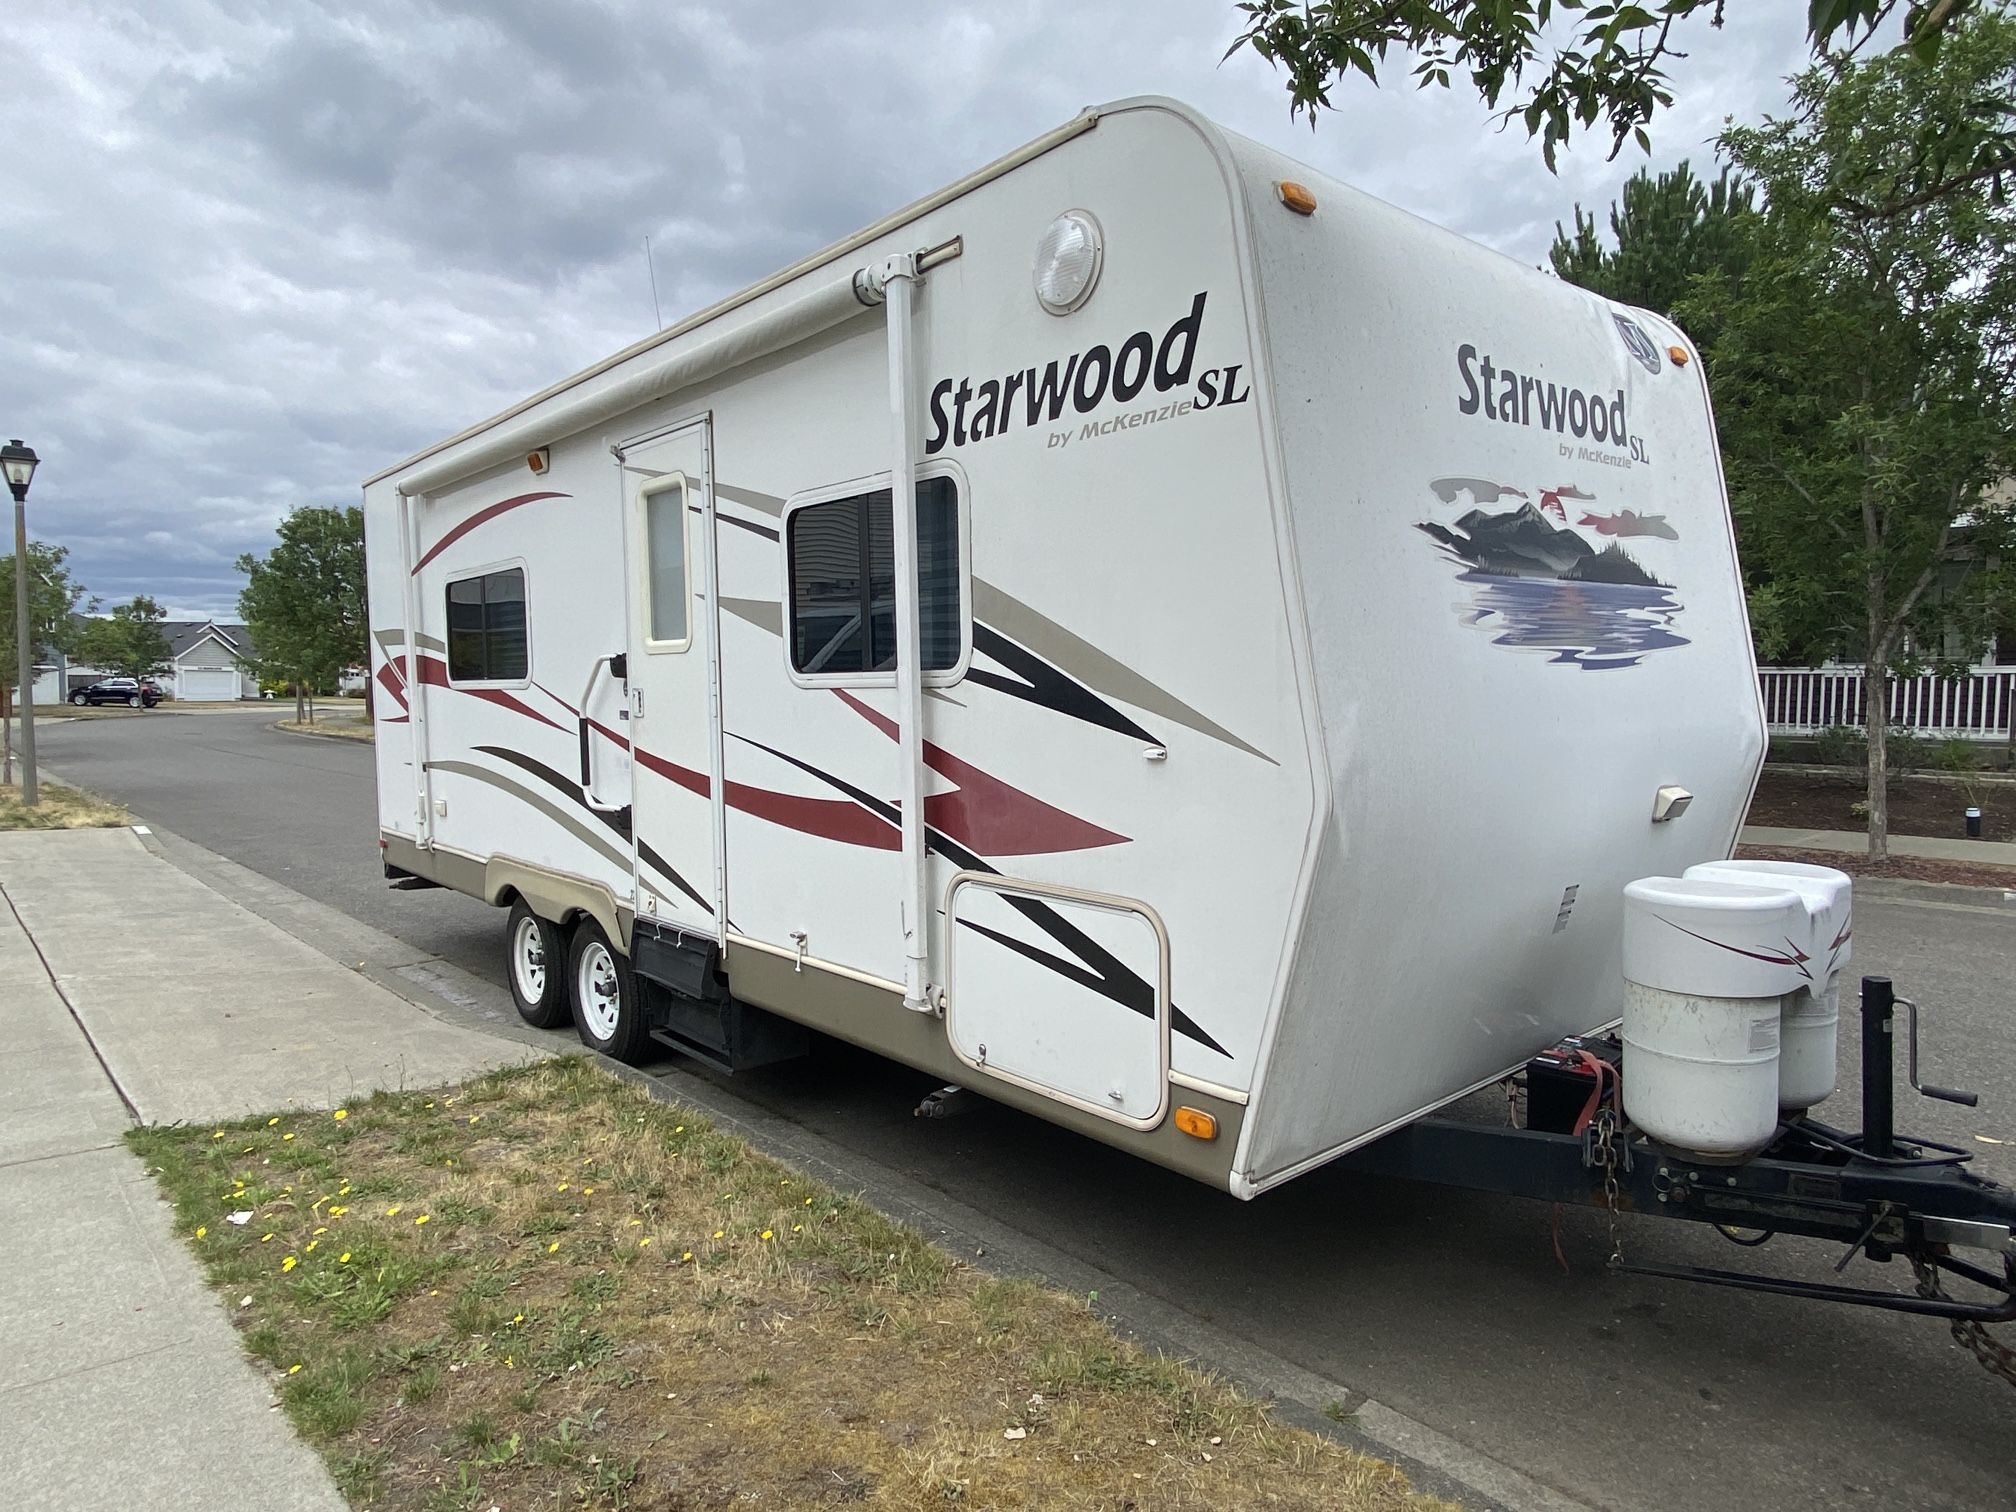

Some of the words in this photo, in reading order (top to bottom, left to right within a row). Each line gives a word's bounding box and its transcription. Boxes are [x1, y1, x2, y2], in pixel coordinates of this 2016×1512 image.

[925, 291, 1208, 455] Starwood
[1193, 364, 1250, 411] SL
[1457, 343, 1628, 448] Starwood
[1630, 435, 1650, 465] SL
[1047, 430, 1073, 449] by
[1079, 401, 1193, 441] McKenzie
[1559, 443, 1574, 460] by
[1578, 448, 1632, 469] McKenzie
